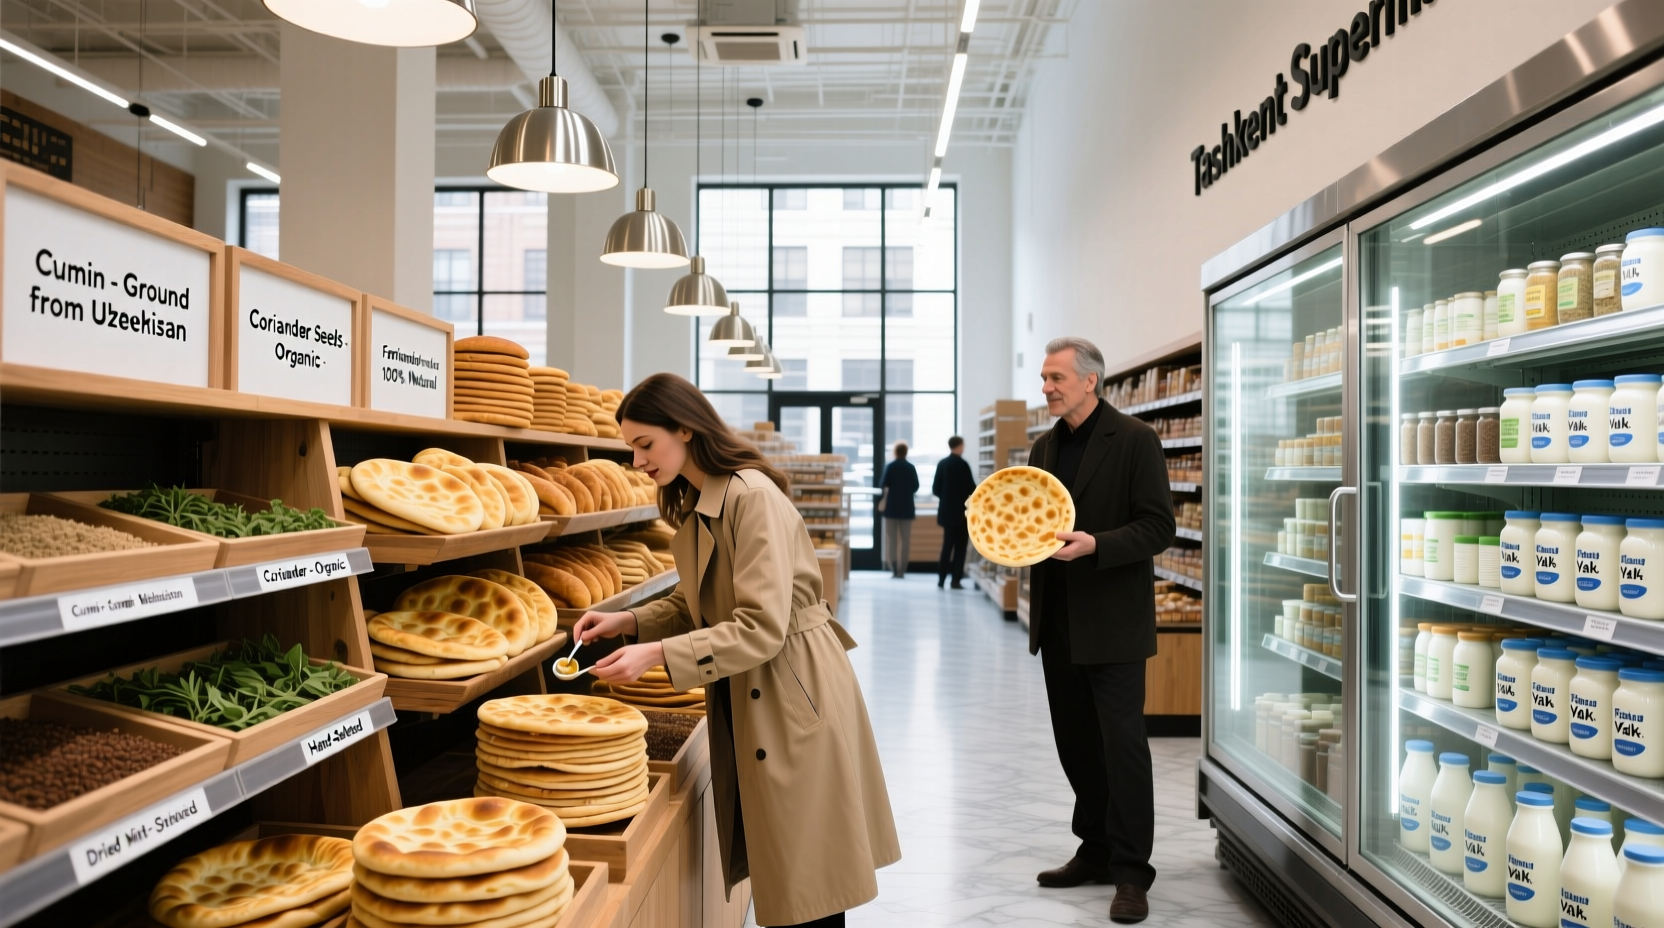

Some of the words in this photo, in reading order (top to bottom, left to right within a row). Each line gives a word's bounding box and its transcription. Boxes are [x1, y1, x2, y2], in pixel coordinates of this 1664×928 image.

[1191, 72, 1288, 197] Tashkent
[1290, 0, 1435, 111] Superm
[35, 248, 105, 290] Cumin
[123, 272, 190, 310] Ground
[29, 285, 84, 322] from
[249, 308, 312, 341] Coriander
[274, 342, 321, 369] Organic
